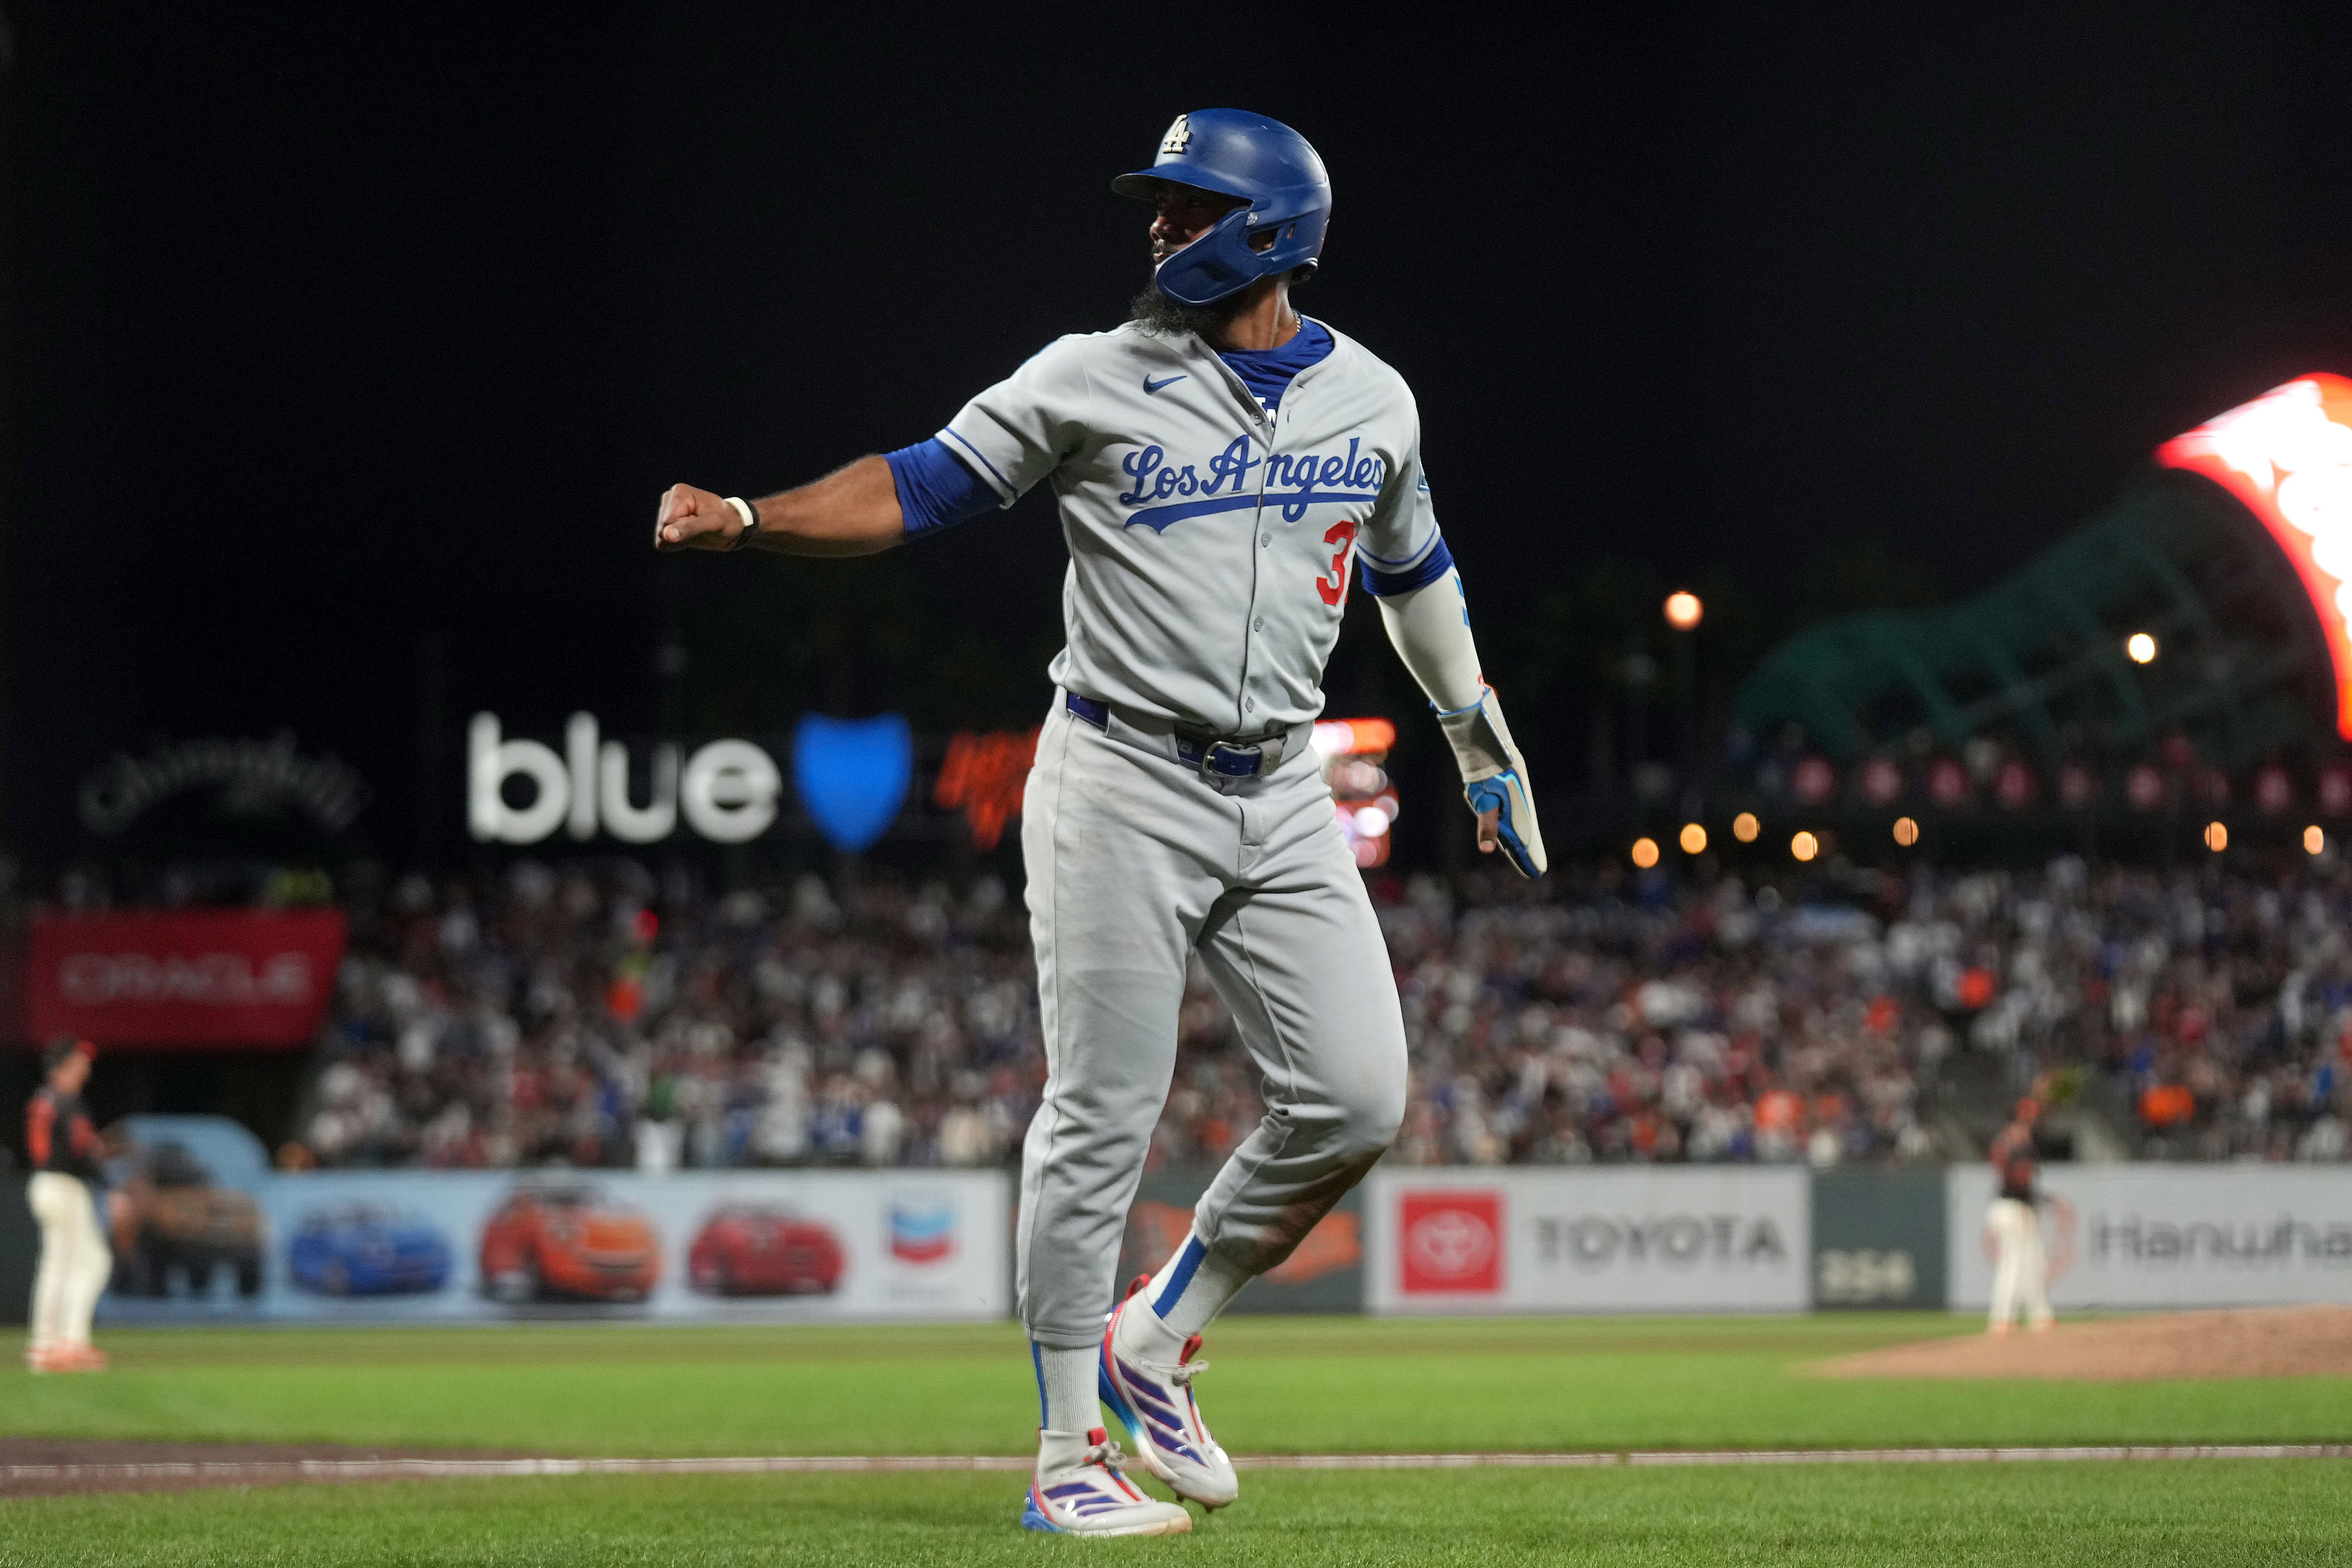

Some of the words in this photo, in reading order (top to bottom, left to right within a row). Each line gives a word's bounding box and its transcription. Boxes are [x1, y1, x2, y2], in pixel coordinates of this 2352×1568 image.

[1163, 114, 1190, 153] LA
[1119, 445, 1199, 505] Los
[1201, 434, 1385, 523] Angeles
[467, 710, 782, 844] blue
[1534, 1211, 1786, 1274] TOYOTA
